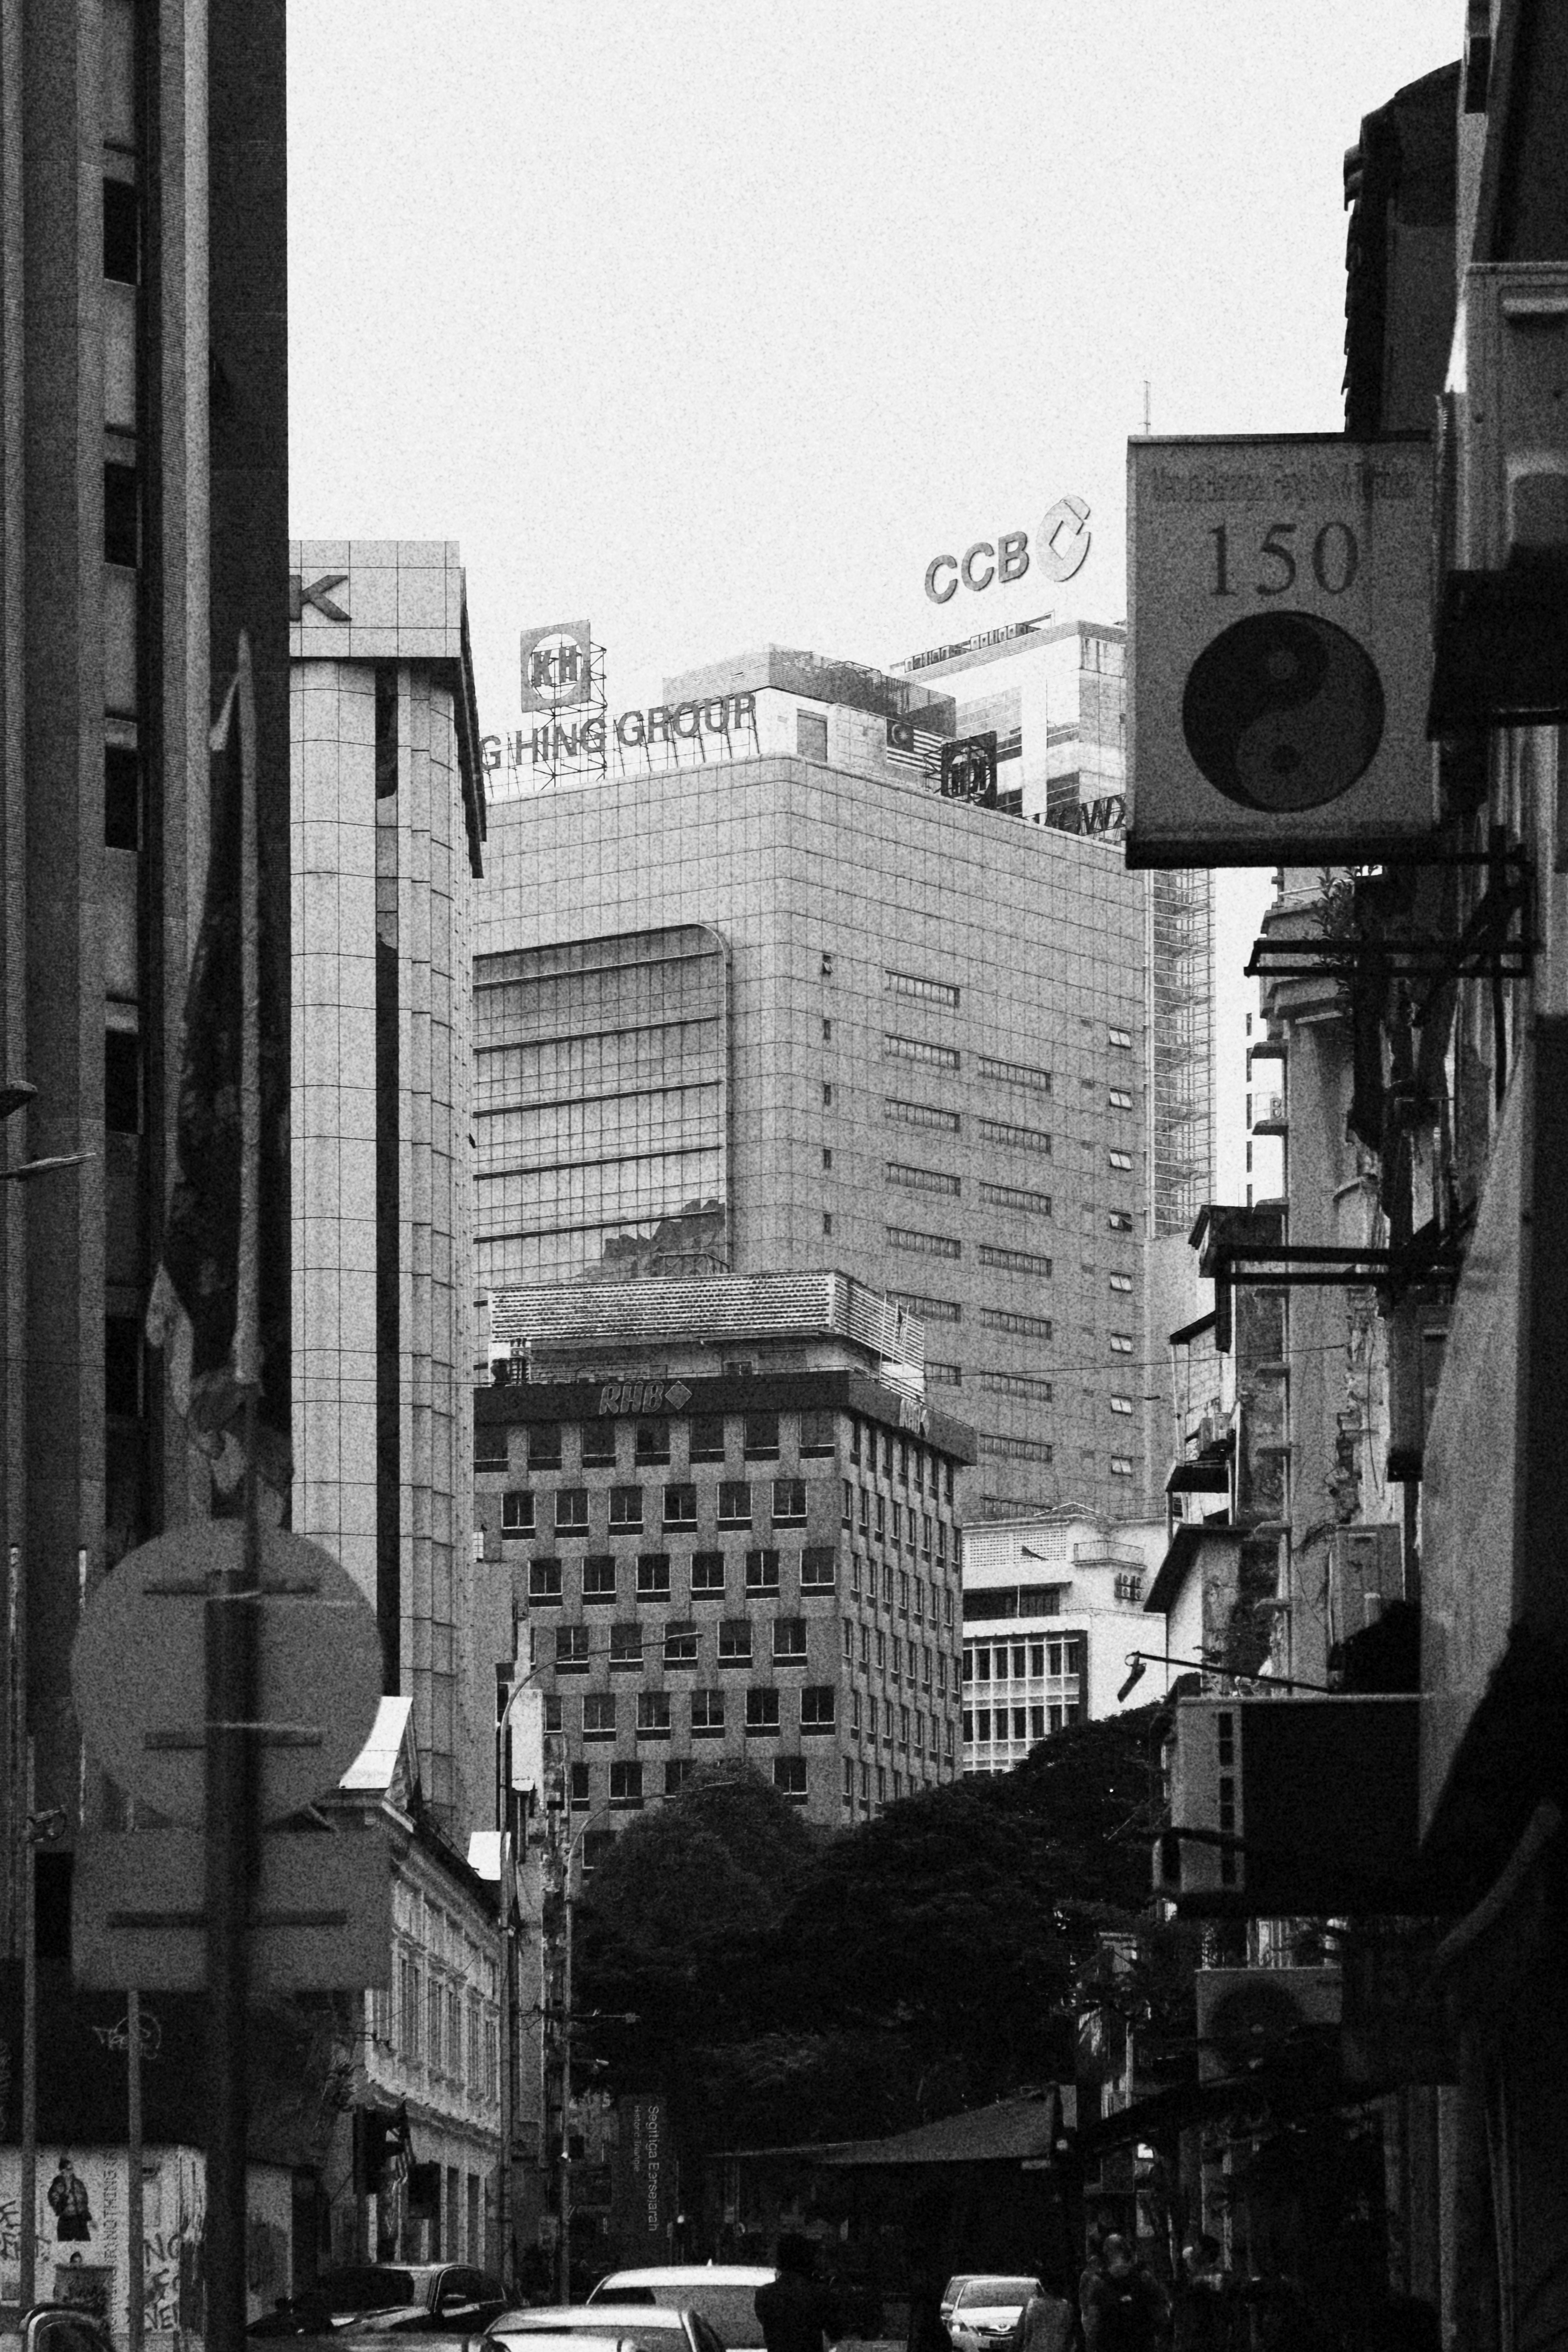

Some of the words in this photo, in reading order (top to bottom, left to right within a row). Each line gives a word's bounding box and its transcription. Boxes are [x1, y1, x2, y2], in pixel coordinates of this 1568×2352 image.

[924, 531, 1029, 604] CCB
[1207, 520, 1359, 596] 150
[515, 718, 606, 764] HING
[617, 692, 755, 746] GROUP
[599, 1380, 664, 1415] RHB
[632, 2140, 641, 2171] Triangle
